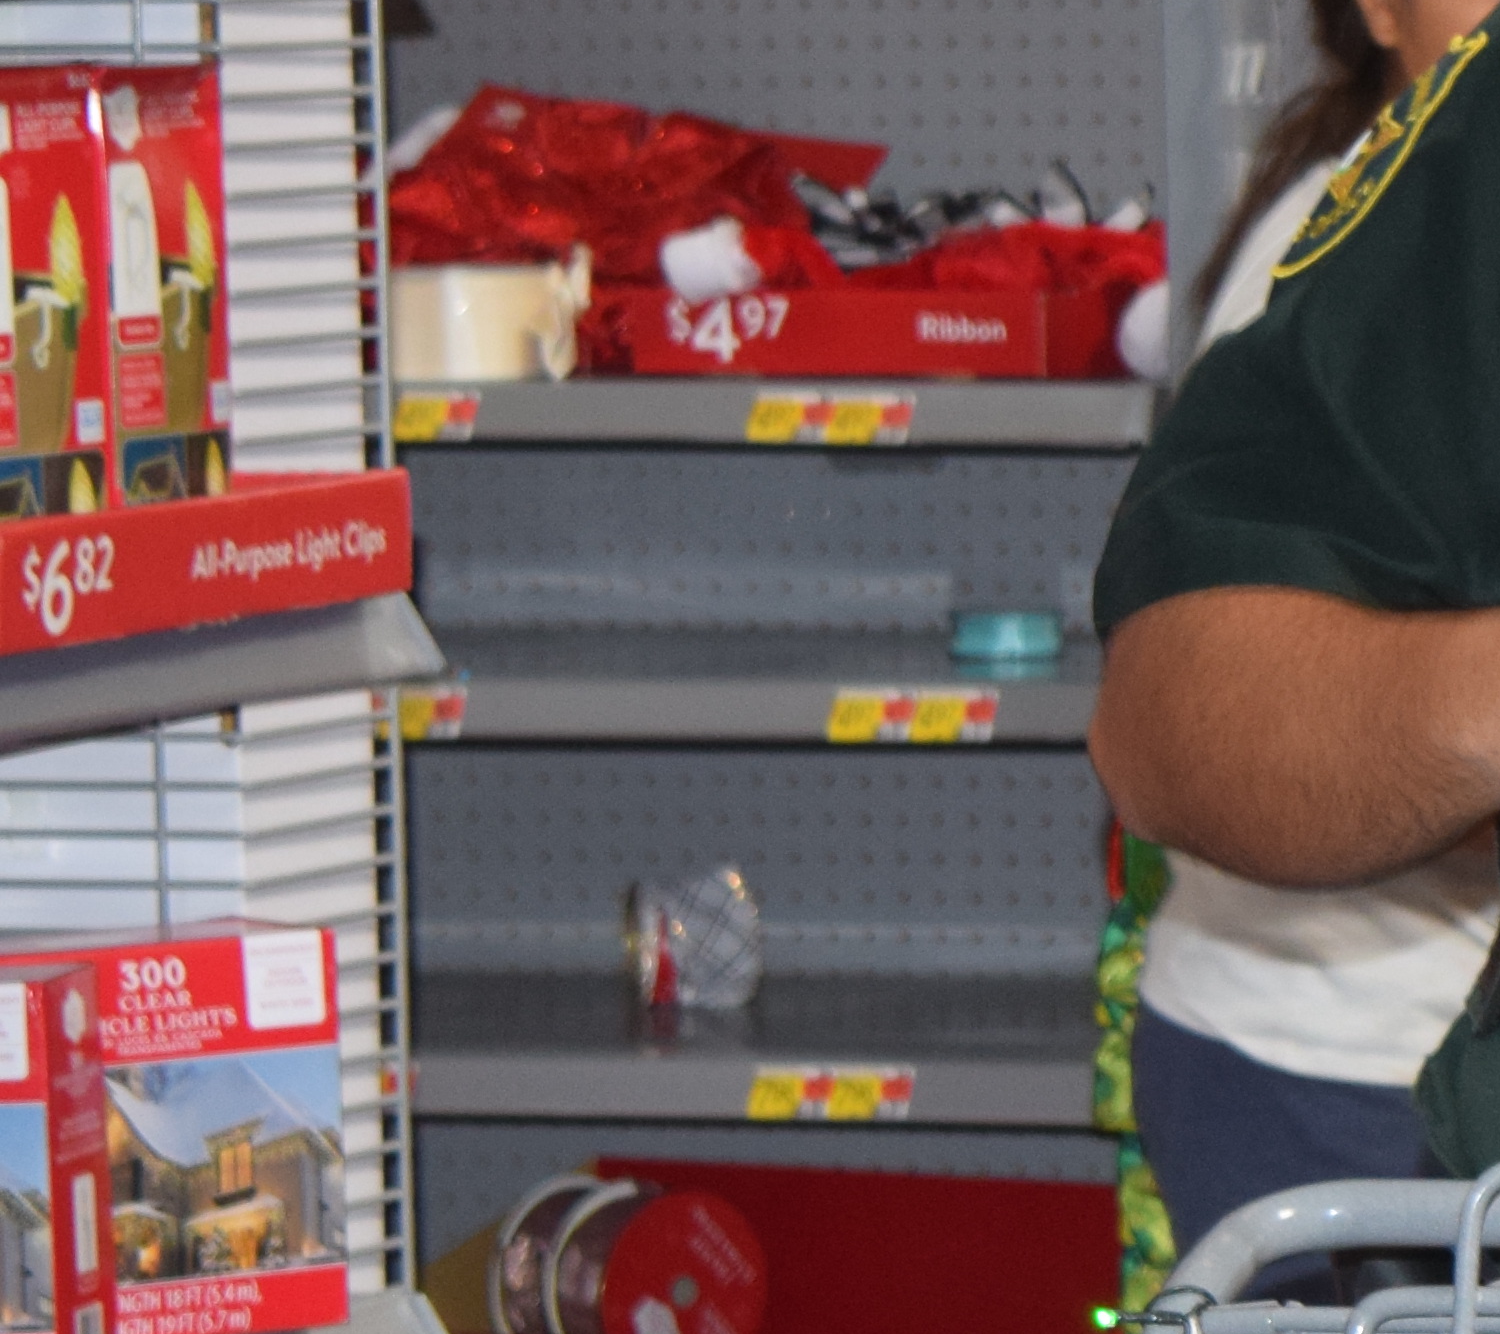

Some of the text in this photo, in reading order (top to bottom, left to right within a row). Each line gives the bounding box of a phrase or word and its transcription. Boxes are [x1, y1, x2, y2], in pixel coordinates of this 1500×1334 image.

[914, 312, 1007, 343] Ribbon
[189, 535, 294, 583] All-Purpose
[296, 525, 341, 572] Light
[117, 954, 187, 991] 300
[117, 990, 193, 1013] CLEAR
[154, 1005, 238, 1033] LIGHTS
